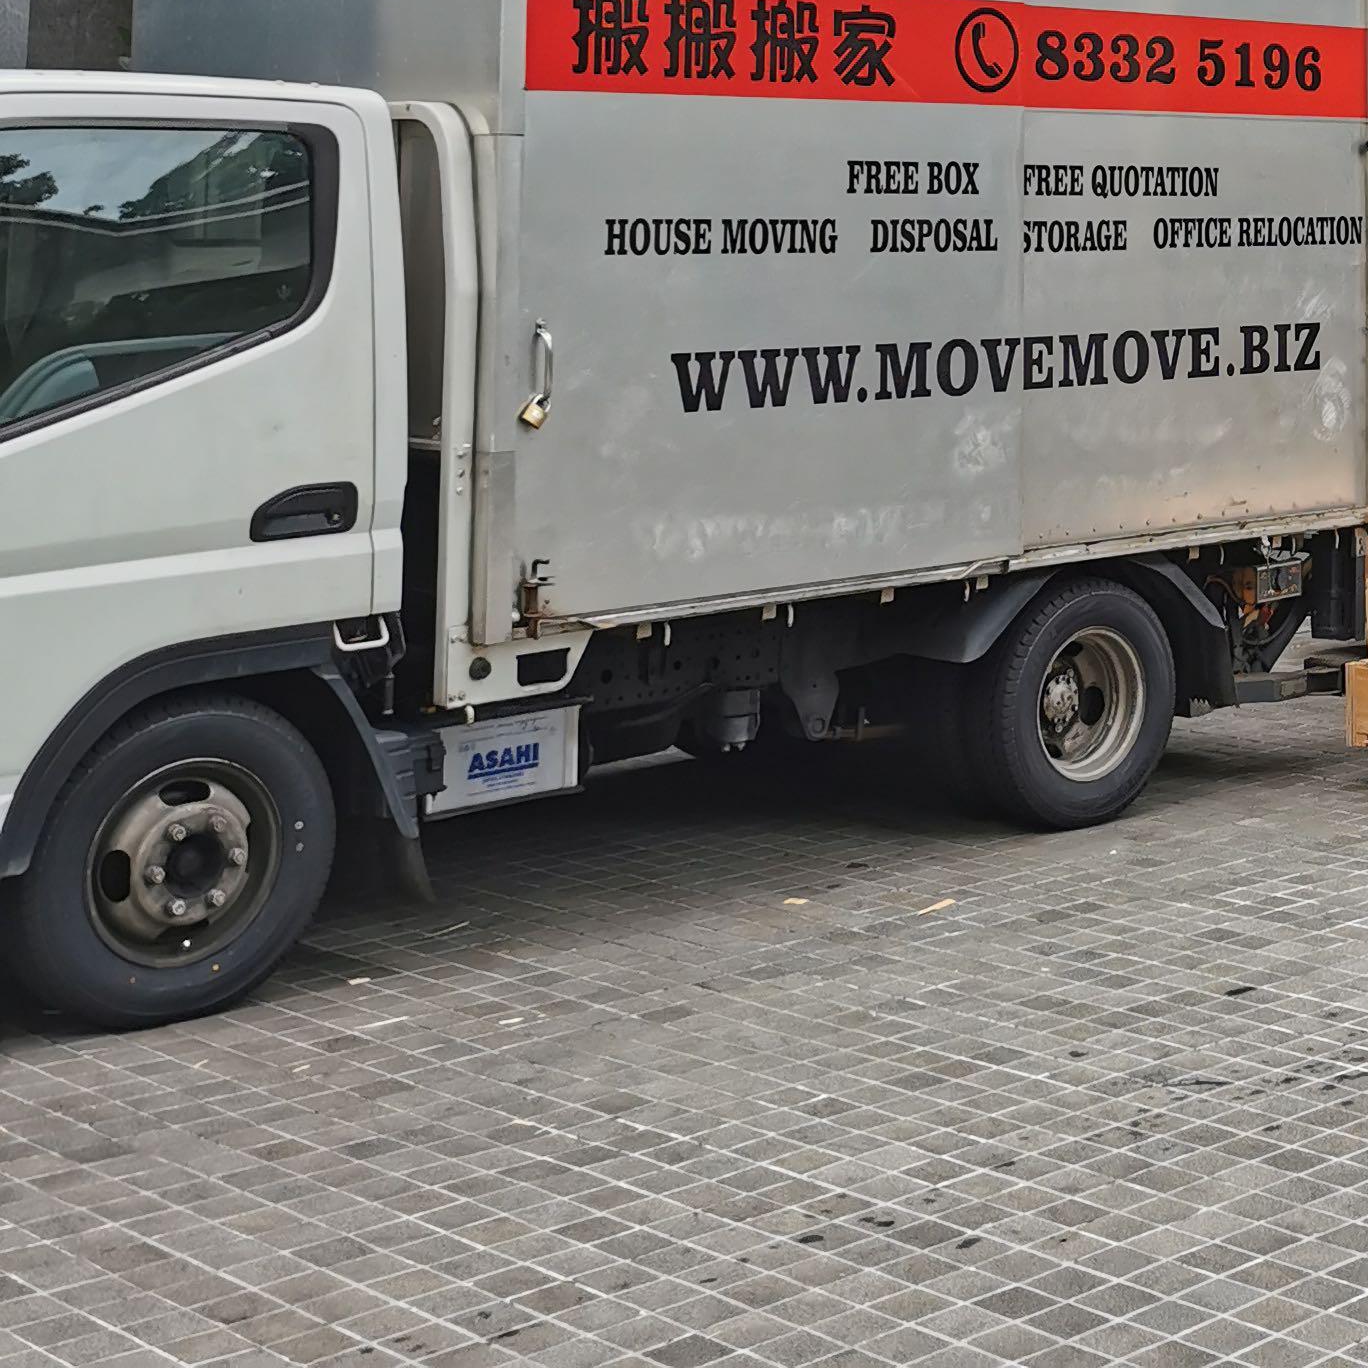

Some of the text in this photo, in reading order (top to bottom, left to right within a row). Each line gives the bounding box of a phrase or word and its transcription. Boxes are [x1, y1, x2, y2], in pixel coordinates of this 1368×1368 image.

[1035, 30, 1322, 91] 8332 5196
[847, 160, 1219, 198] FREE BOX FREE QUOTATION
[604, 218, 712, 256] HOUSE
[720, 218, 838, 255] MOVING
[869, 218, 998, 253] DISPOSAL
[1153, 217, 1232, 249] OFFICE
[1237, 215, 1363, 248] RELOCATION
[670, 322, 1321, 413] WWW.MOVEMOVE.BIZ
[468, 742, 540, 774] ASAHI
